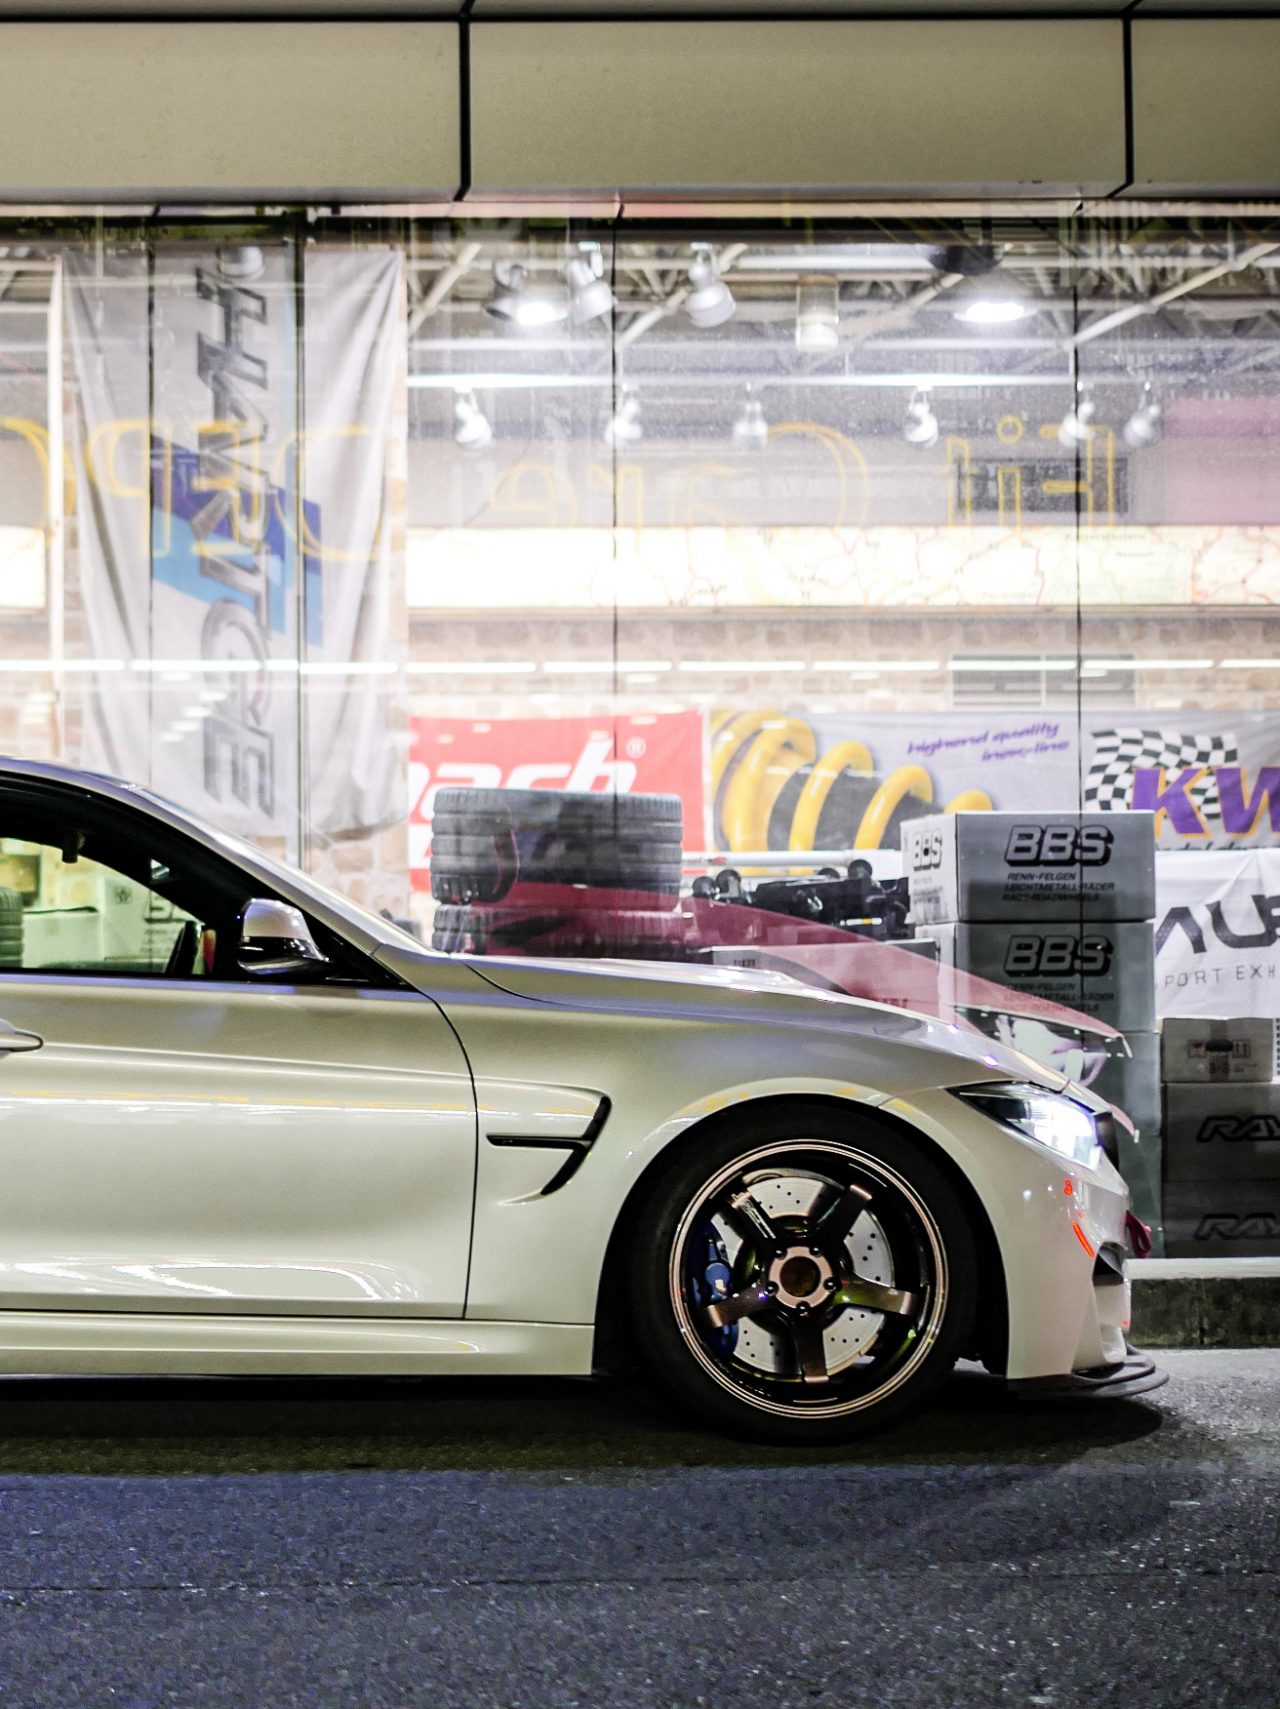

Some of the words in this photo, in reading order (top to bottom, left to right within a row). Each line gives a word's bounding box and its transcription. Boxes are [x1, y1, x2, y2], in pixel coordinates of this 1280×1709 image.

[192, 266, 276, 820] HARTGE
[992, 722, 1060, 744] quality
[1004, 824, 1114, 866] BBS
[1004, 935, 1114, 977] BBS
[1162, 966, 1224, 990] PORT
